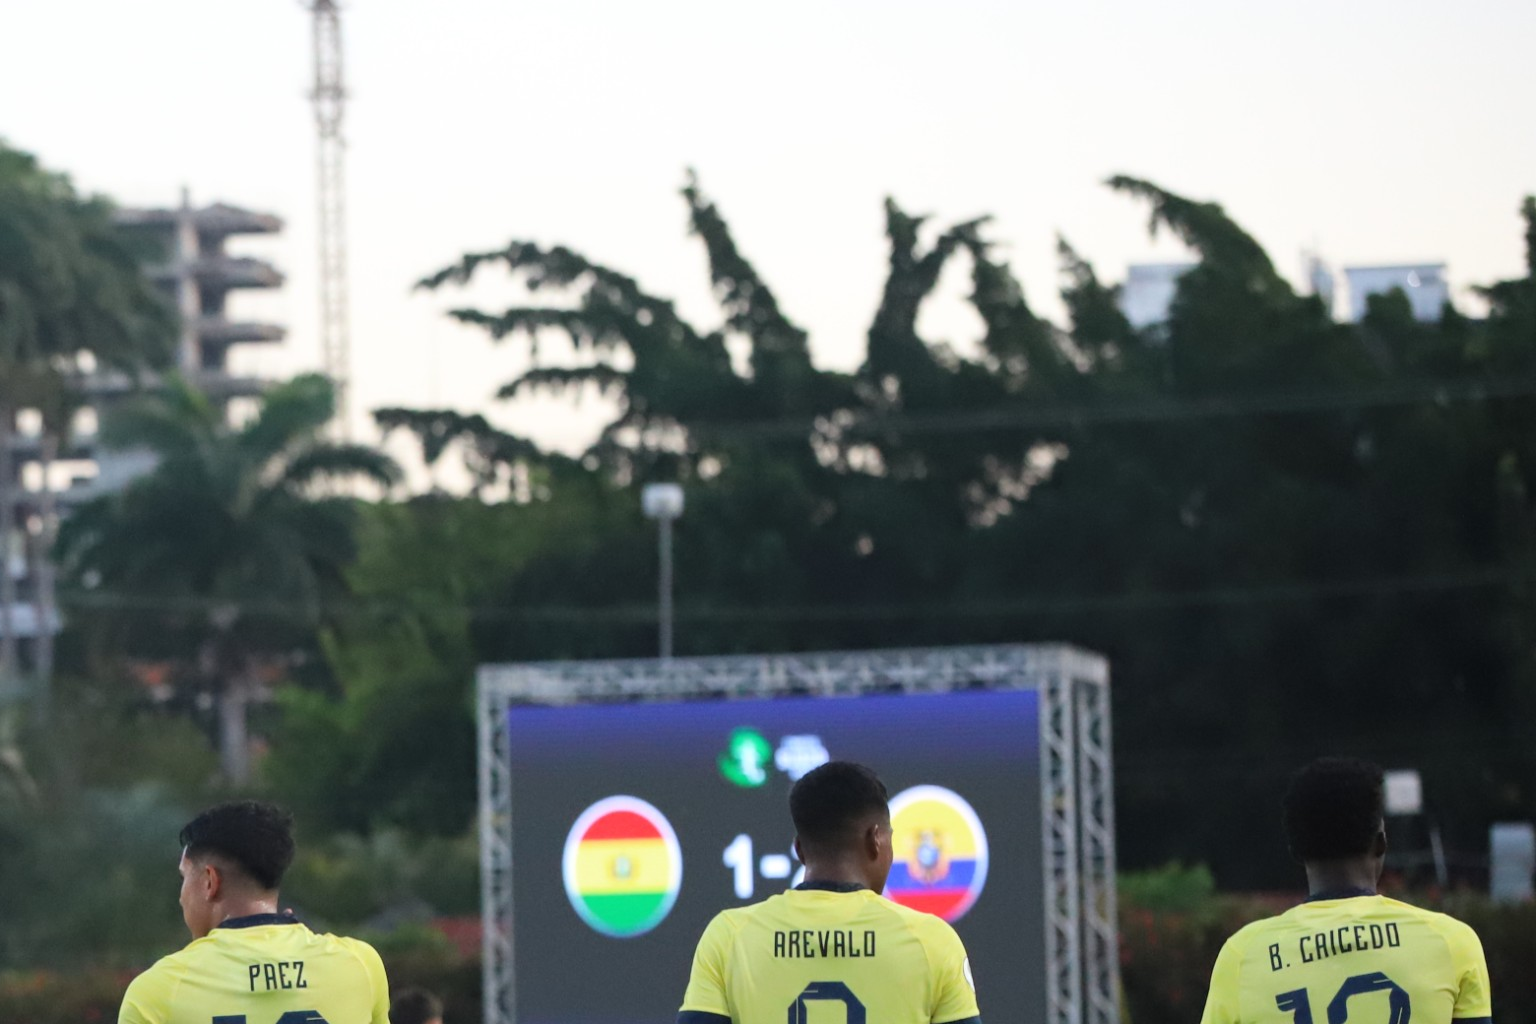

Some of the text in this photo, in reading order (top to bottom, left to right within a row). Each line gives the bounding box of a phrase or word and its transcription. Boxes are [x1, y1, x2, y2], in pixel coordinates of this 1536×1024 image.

[774, 930, 876, 959] AREVALO
[1269, 922, 1400, 972] B. CAICEDO
[249, 960, 308, 991] PAEZ
